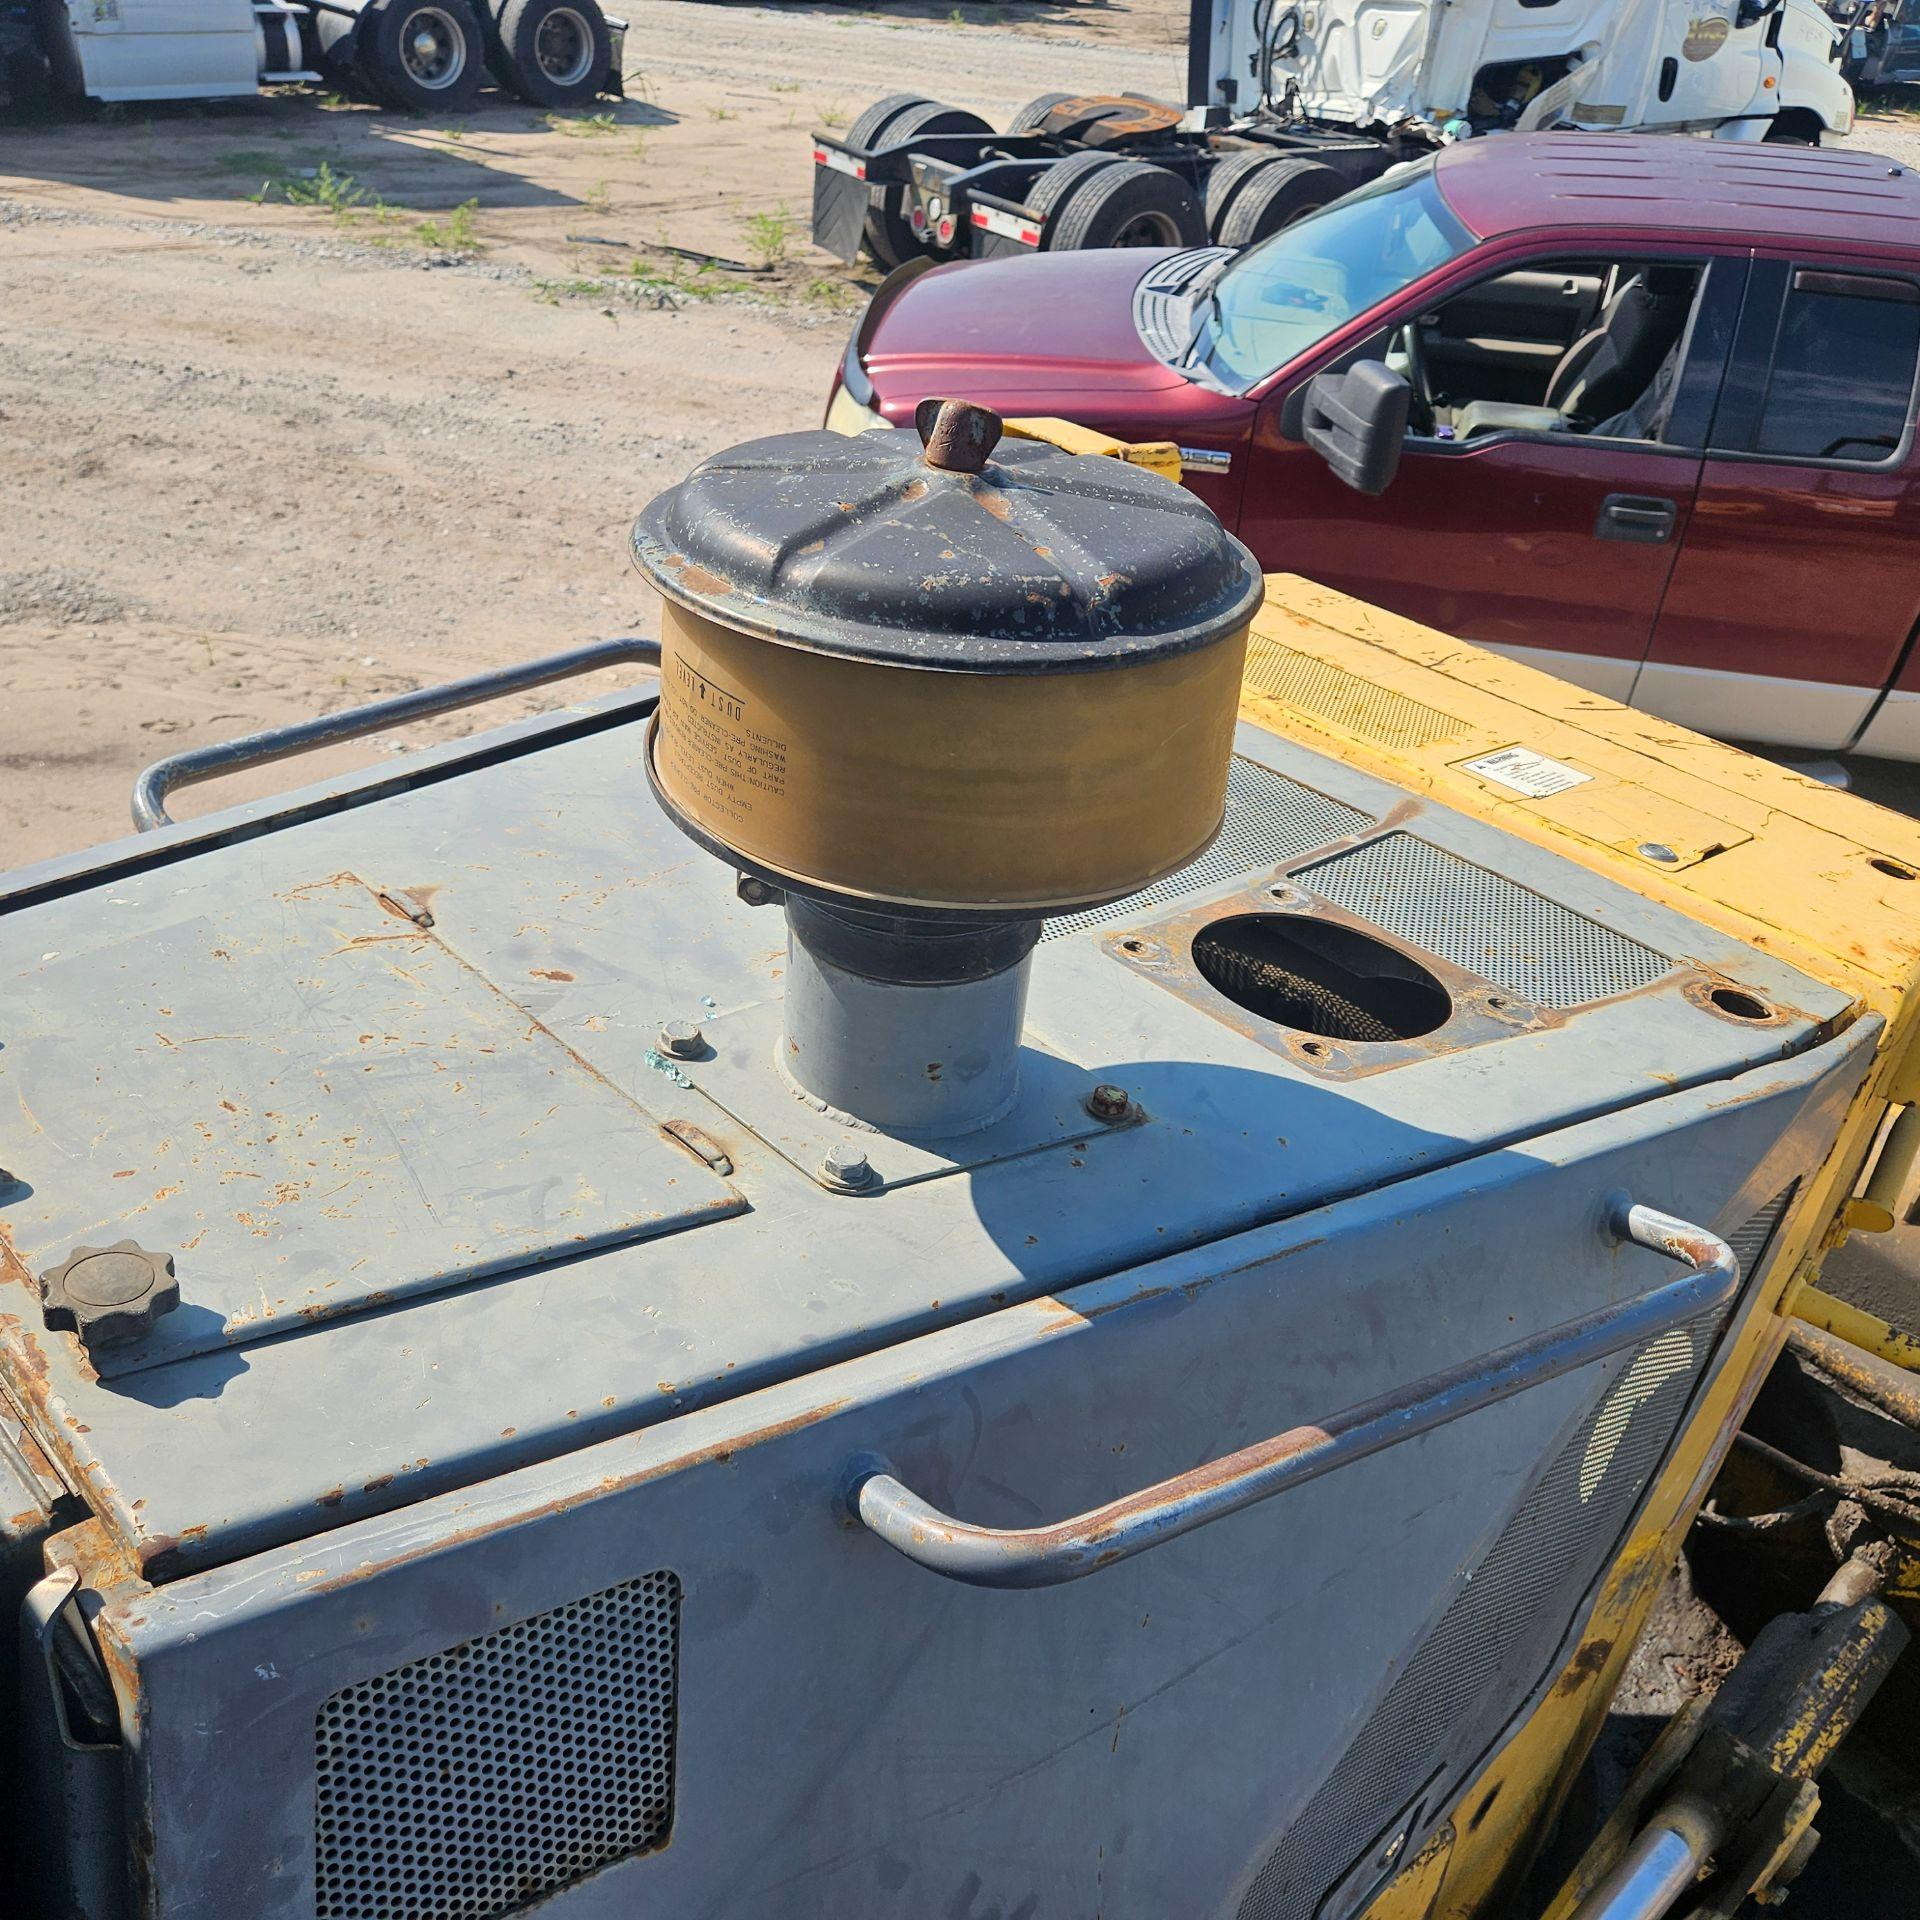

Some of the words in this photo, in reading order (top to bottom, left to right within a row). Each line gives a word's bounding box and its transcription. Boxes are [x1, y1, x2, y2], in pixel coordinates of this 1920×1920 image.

[676, 661, 694, 692] LEVEL
[711, 692, 741, 721] DUST
[700, 715, 746, 748] PRE-CLEANER
[725, 742, 734, 753] AS
[750, 743, 786, 762] WASHING
[724, 753, 742, 768] DUST
[738, 749, 786, 773] REGULARLY
[698, 763, 712, 779] DUST
[730, 768, 746, 782] THIS
[747, 765, 757, 775] OF
[763, 772, 784, 784] PART
[706, 781, 723, 795] DUST
[716, 775, 734, 789] WHEN
[703, 795, 744, 823] COLLECTOR
[727, 793, 752, 811] EMPTY
